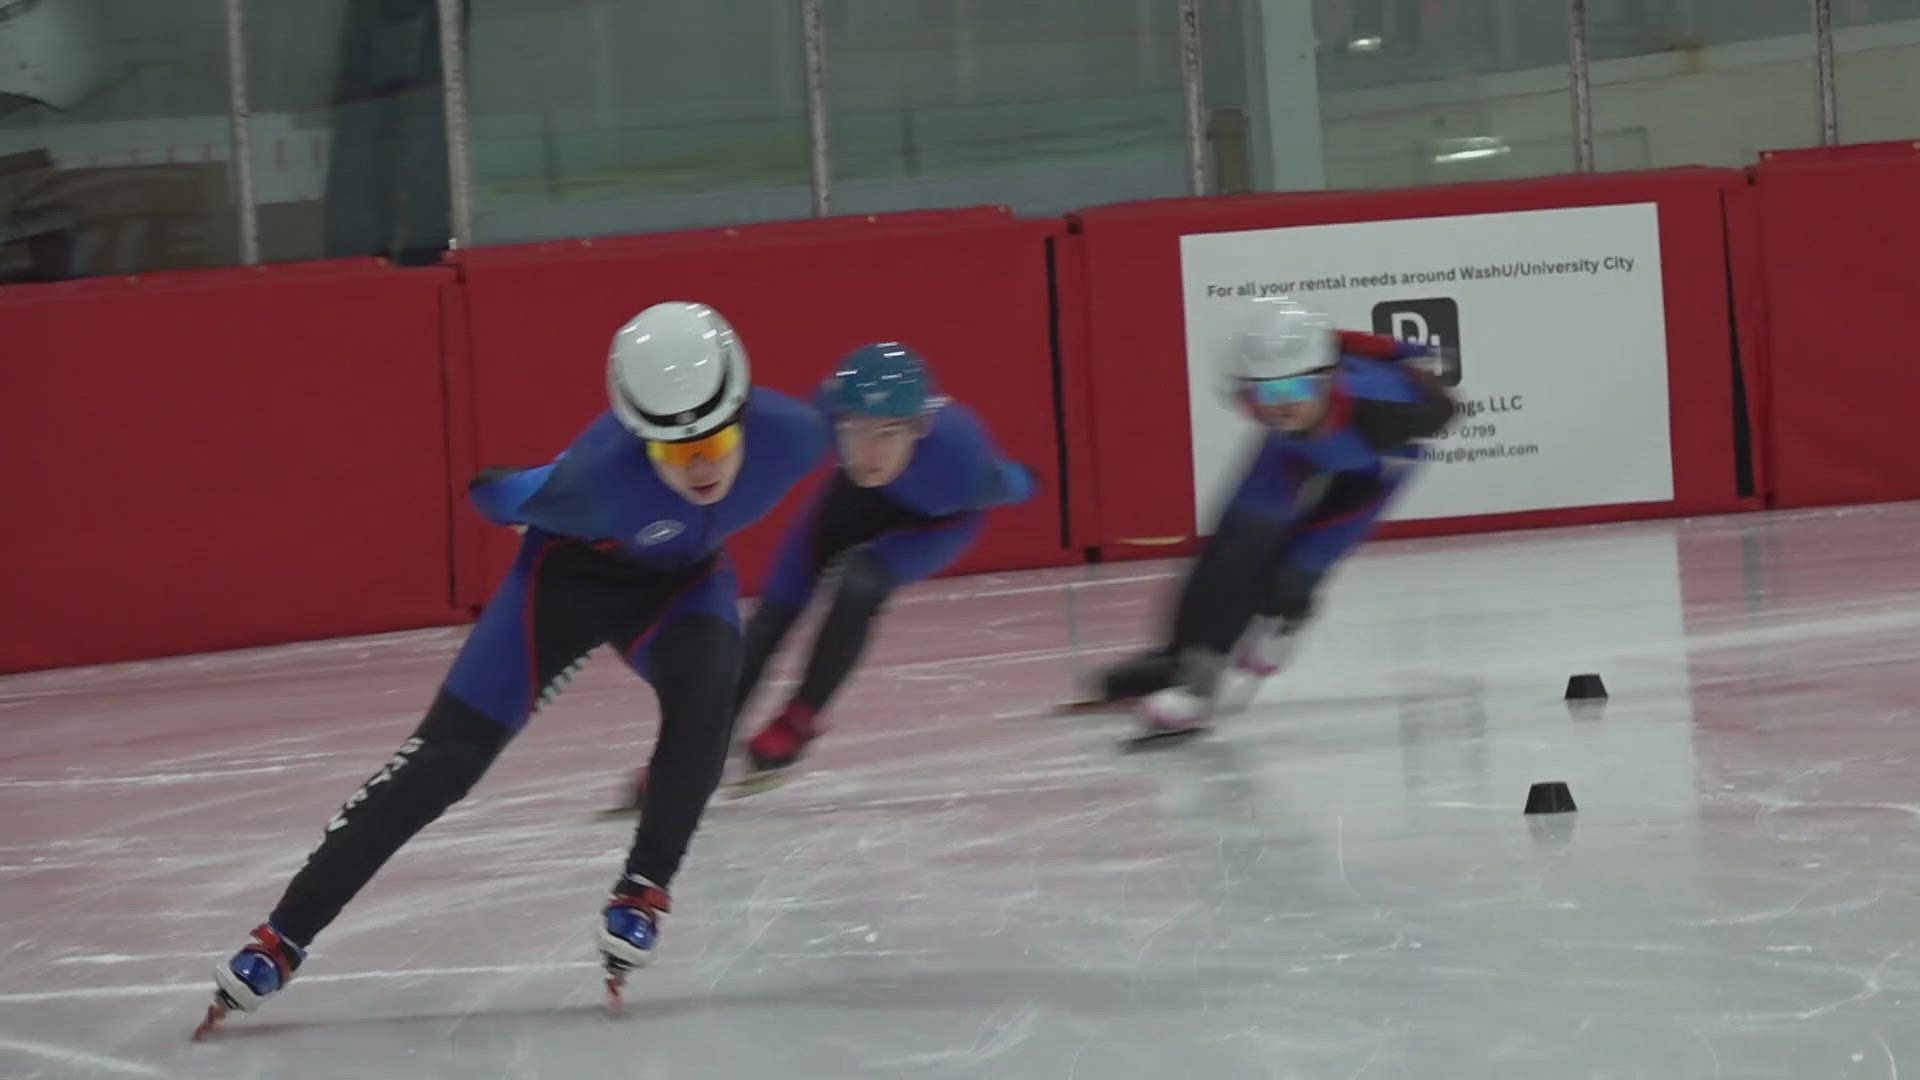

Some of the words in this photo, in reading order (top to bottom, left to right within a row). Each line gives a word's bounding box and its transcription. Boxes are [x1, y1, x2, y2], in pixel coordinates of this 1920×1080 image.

[1207, 284, 1232, 298] For
[1237, 281, 1256, 296] all
[1259, 281, 1295, 298] your
[1299, 275, 1347, 292] rental
[1350, 272, 1397, 287] needs
[1401, 268, 1456, 284] around
[1459, 259, 1599, 280] WashU/University
[1603, 256, 1635, 273] City
[1489, 395, 1523, 412] LLC
